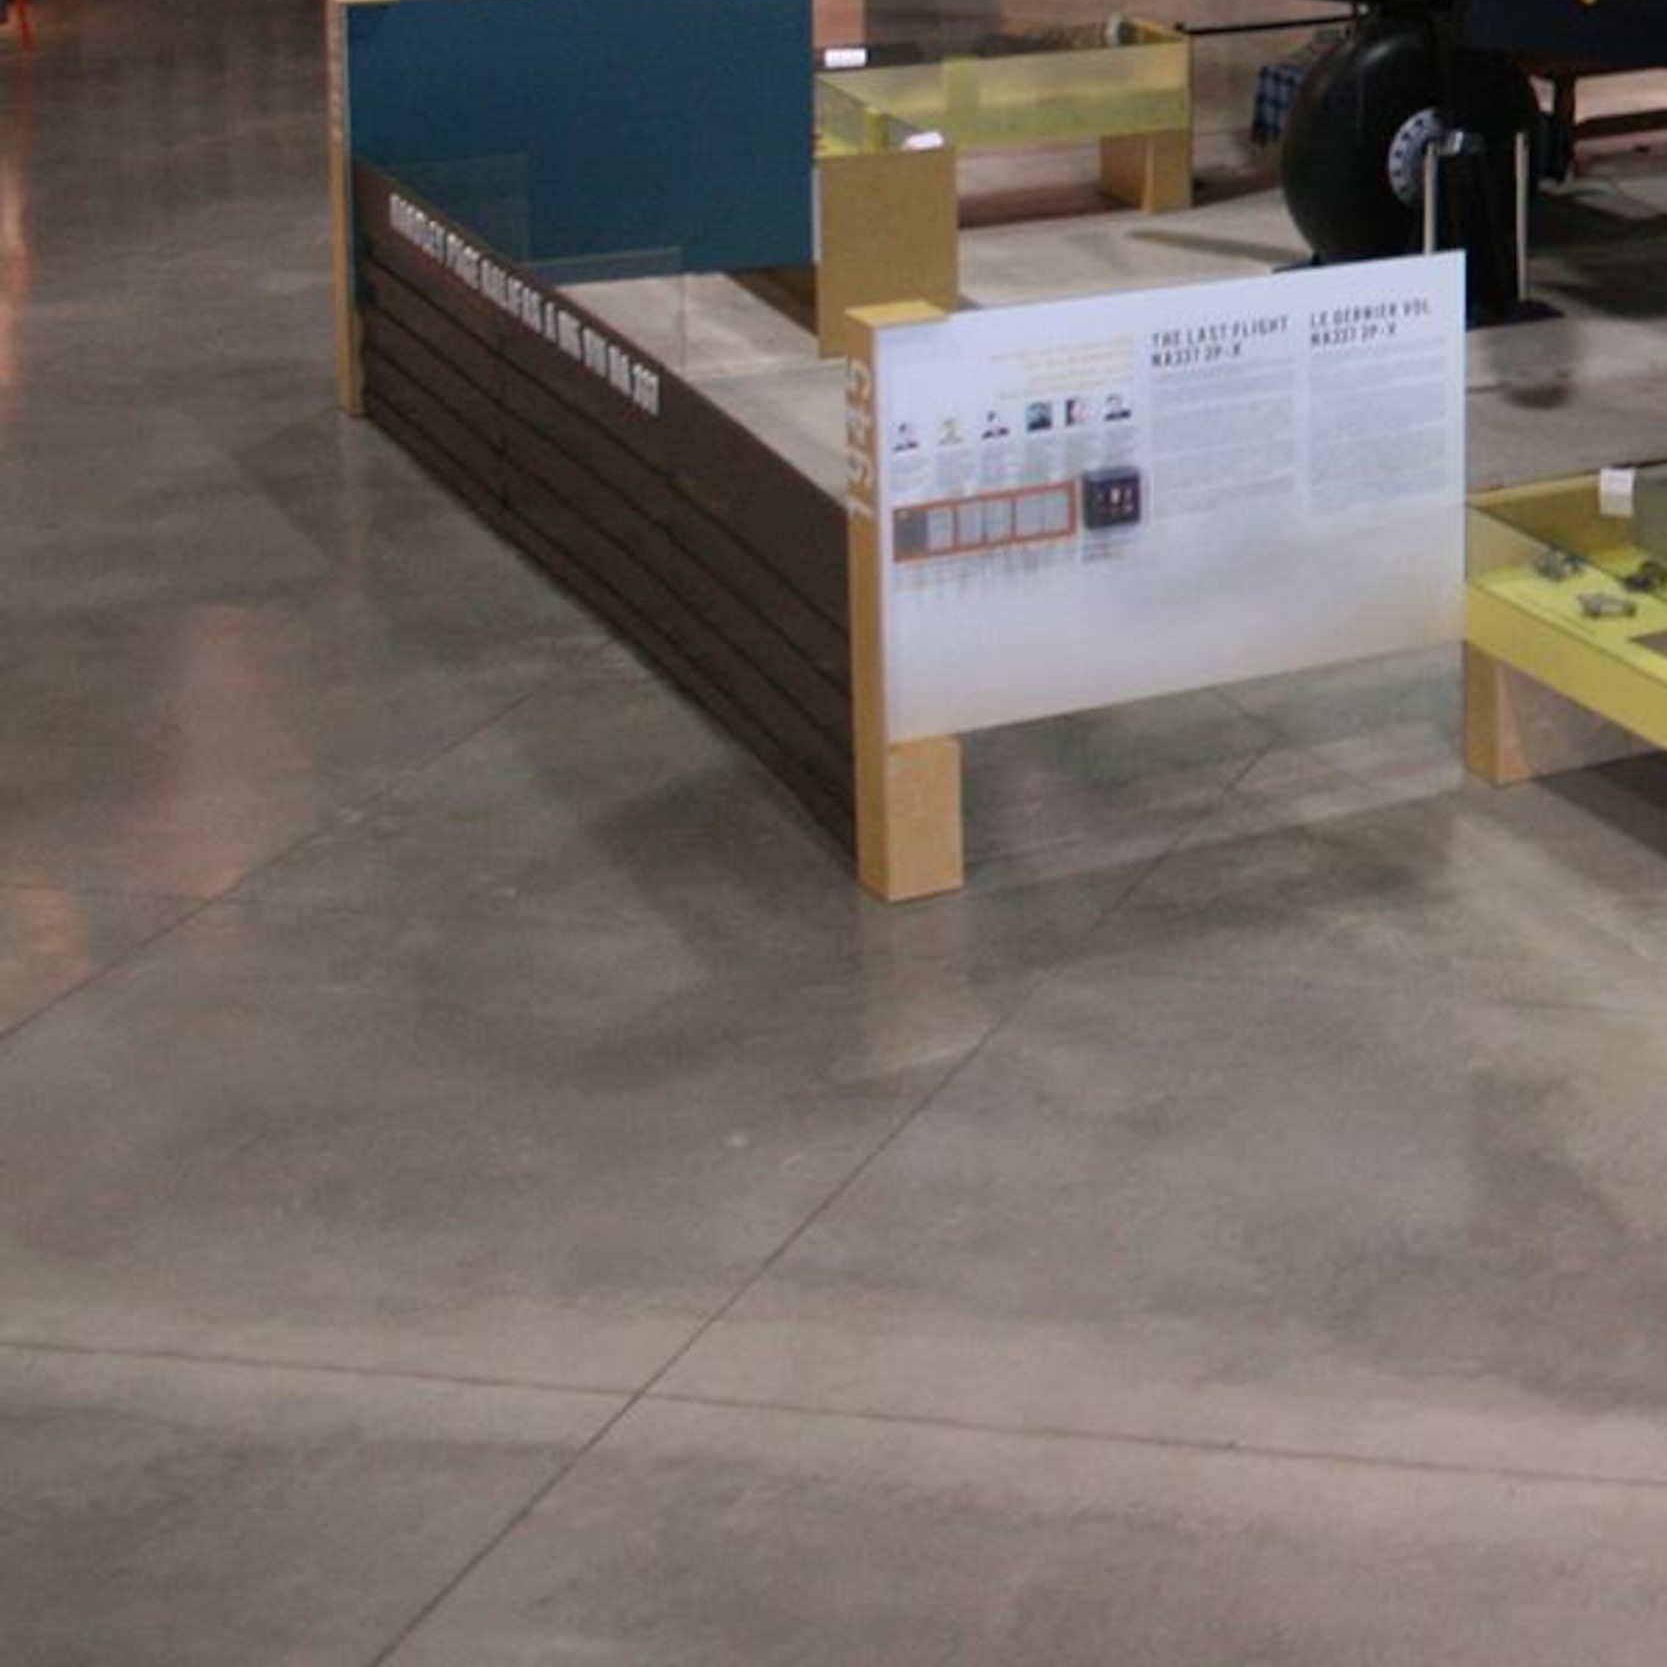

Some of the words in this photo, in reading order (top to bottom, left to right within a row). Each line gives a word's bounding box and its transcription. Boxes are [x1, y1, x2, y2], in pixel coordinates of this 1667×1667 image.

[1152, 330, 1181, 348] THE
[1187, 323, 1227, 345] LAST
[1232, 314, 1288, 338] FLIGHT
[1310, 310, 1327, 328] LE
